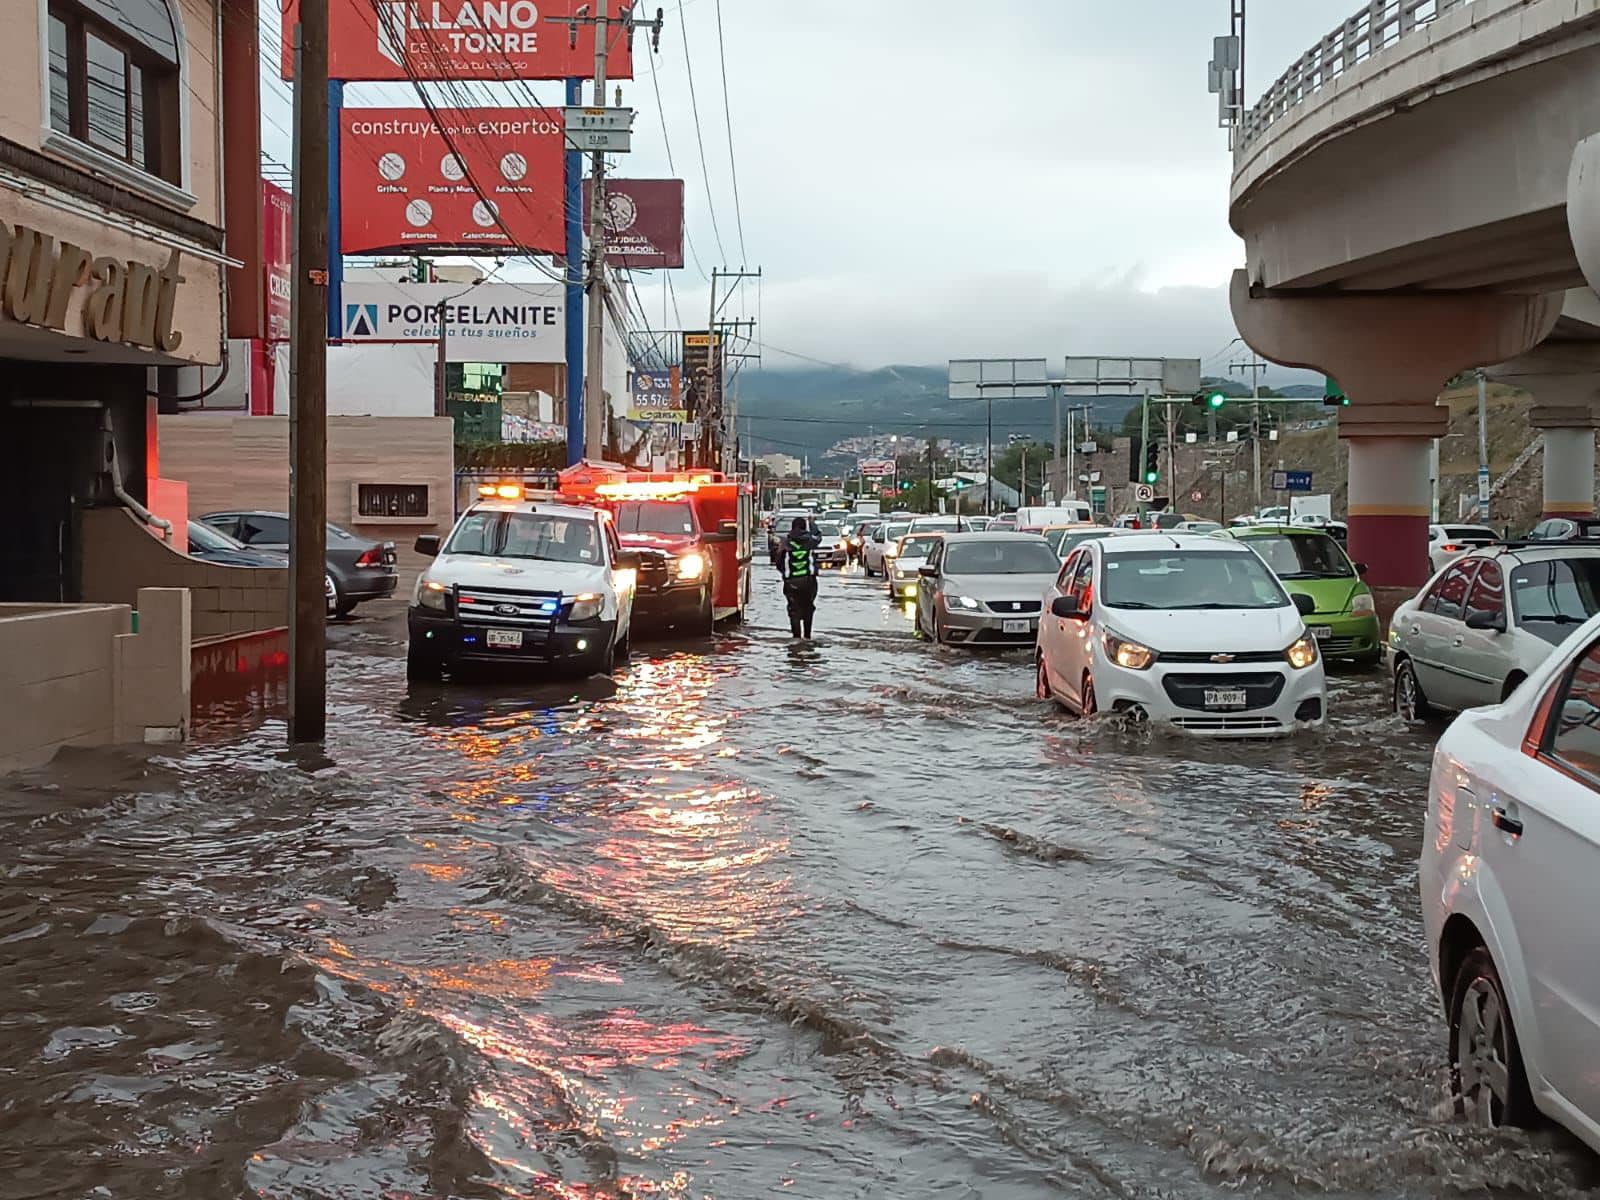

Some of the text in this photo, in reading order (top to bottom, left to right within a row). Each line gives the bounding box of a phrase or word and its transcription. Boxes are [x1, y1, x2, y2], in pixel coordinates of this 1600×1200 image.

[449, 32, 537, 53] TORRE
[352, 120, 441, 138] construye
[478, 118, 560, 138] expertos
[403, 325, 537, 338] celeba tus sueños
